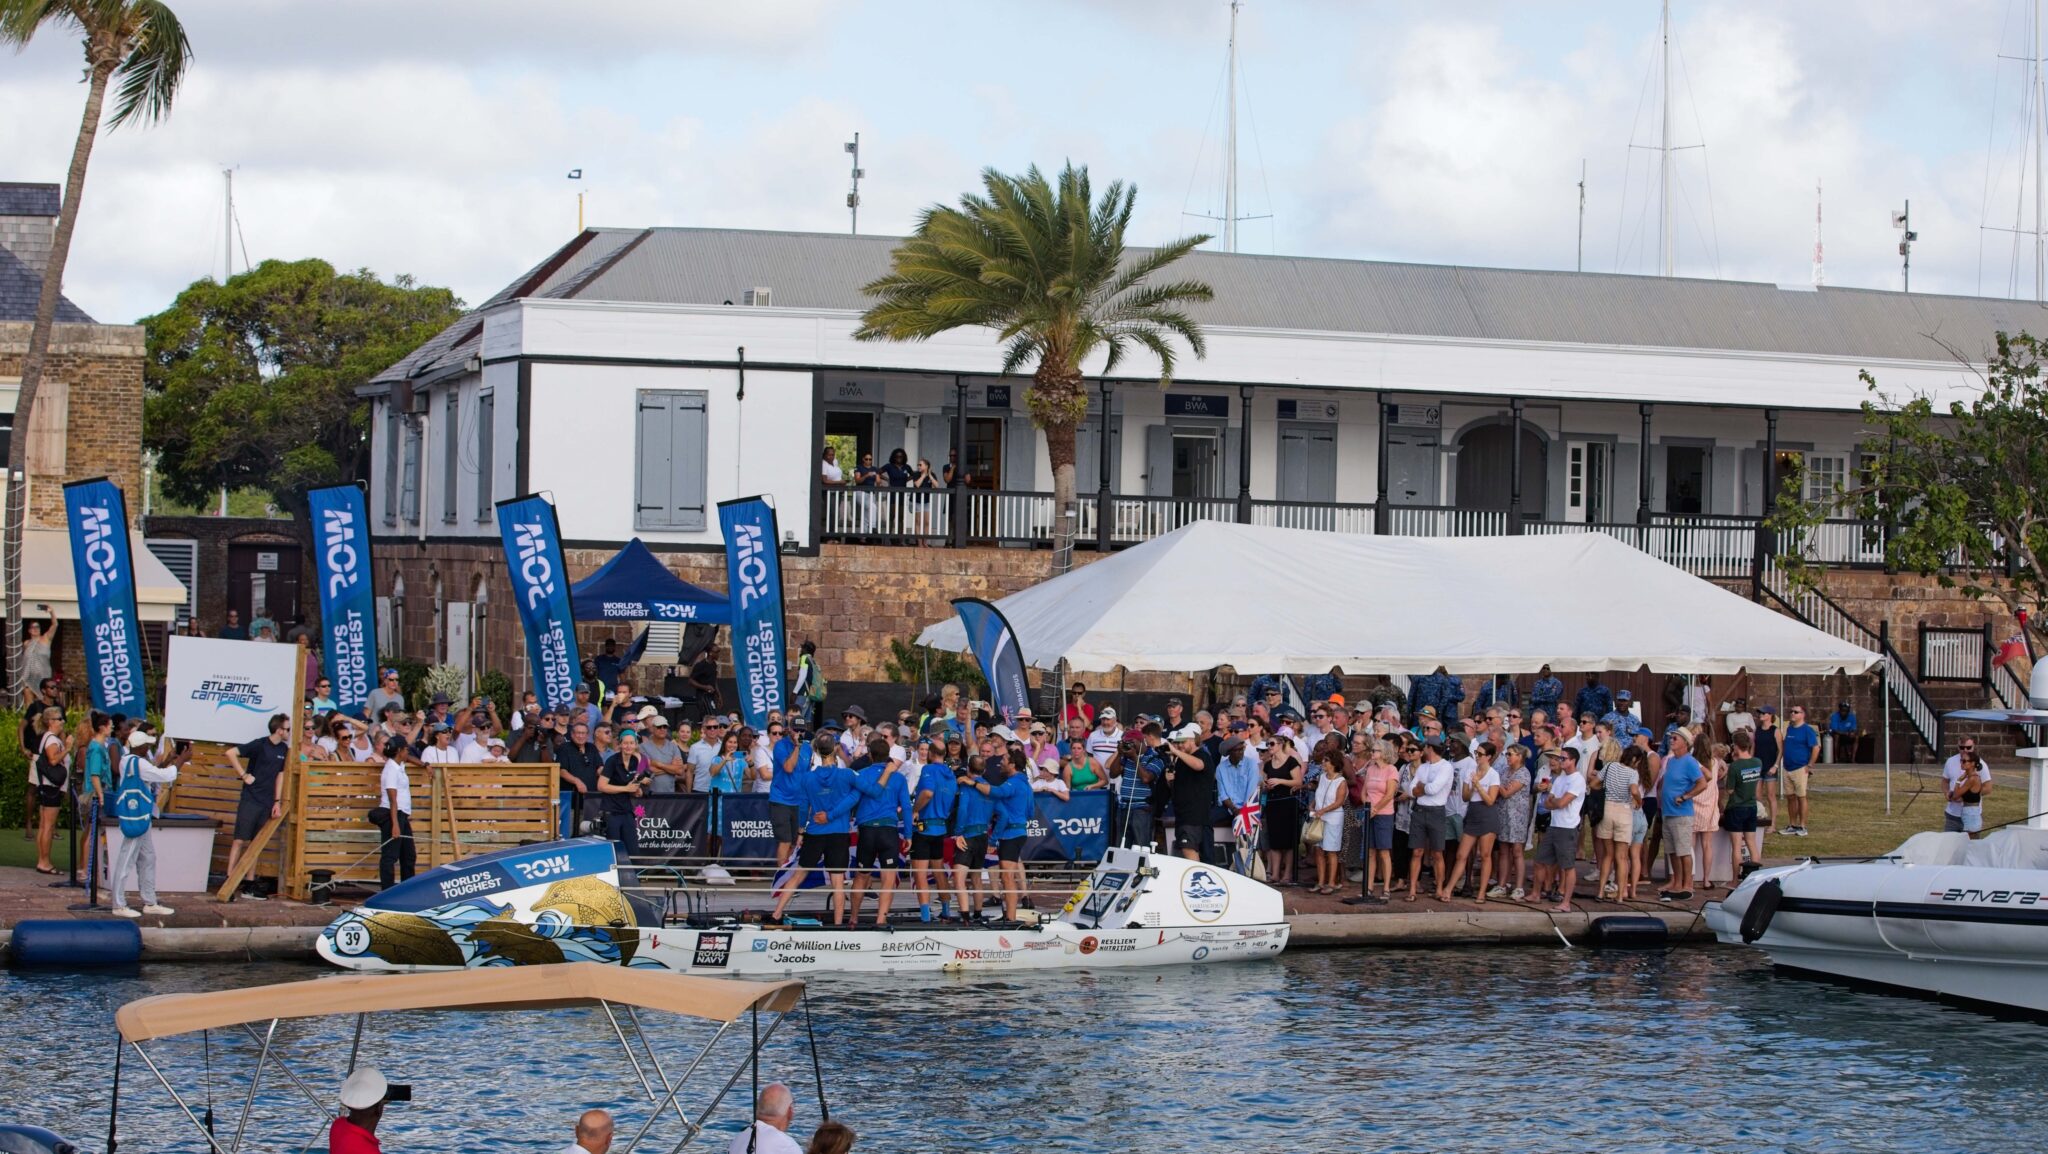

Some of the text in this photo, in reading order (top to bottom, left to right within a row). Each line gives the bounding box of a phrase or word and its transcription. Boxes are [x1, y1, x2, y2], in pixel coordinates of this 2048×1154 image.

[839, 386, 863, 396] BWA
[1184, 401, 1208, 411] BWA
[80, 506, 118, 598] ROW
[323, 509, 357, 599] ROW
[513, 522, 555, 610] ROW
[734, 524, 769, 611] ROW
[602, 602, 643, 610] WORLD'S
[603, 609, 650, 618] TOUGHEST
[654, 602, 697, 619] ROW
[95, 622, 120, 708] WORLD'S
[108, 607, 135, 706] TOUGHEST
[334, 624, 354, 707] WORLD'S
[347, 609, 368, 706] TOUGHEST
[548, 618, 574, 704] OUGHEST
[746, 634, 767, 715] WORLD'S
[730, 829, 775, 839] TOUGHES
[1053, 817, 1102, 835] ROW
[515, 854, 570, 880] ROW
[440, 870, 491, 891] WORLD'S
[441, 877, 502, 899] TOUGHEST
[345, 931, 361, 946] 39
[769, 940, 861, 951] One Million Lives
[881, 941, 942, 952] BREMONT
[696, 956, 725, 964] NAVY
[773, 953, 816, 964] Jacobs
